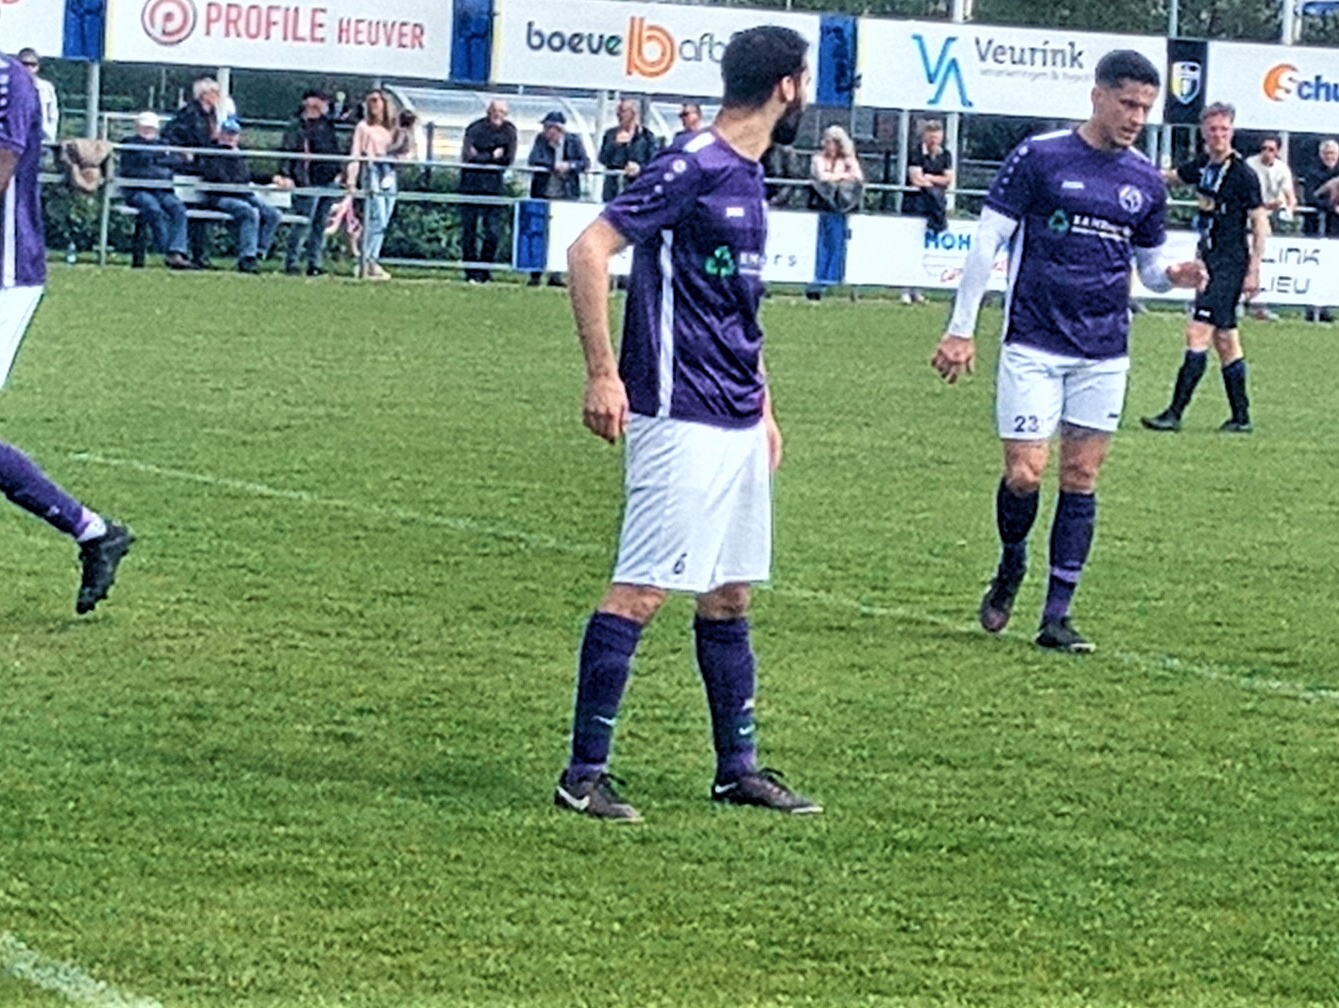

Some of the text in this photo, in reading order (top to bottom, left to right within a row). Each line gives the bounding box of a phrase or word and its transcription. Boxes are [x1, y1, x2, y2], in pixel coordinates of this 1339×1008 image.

[204, 2, 426, 50] PROFILE HEUVER
[526, 20, 623, 56] boeve
[679, 33, 730, 64] afb
[1014, 415, 1040, 433] 23
[673, 553, 688, 575] 6
